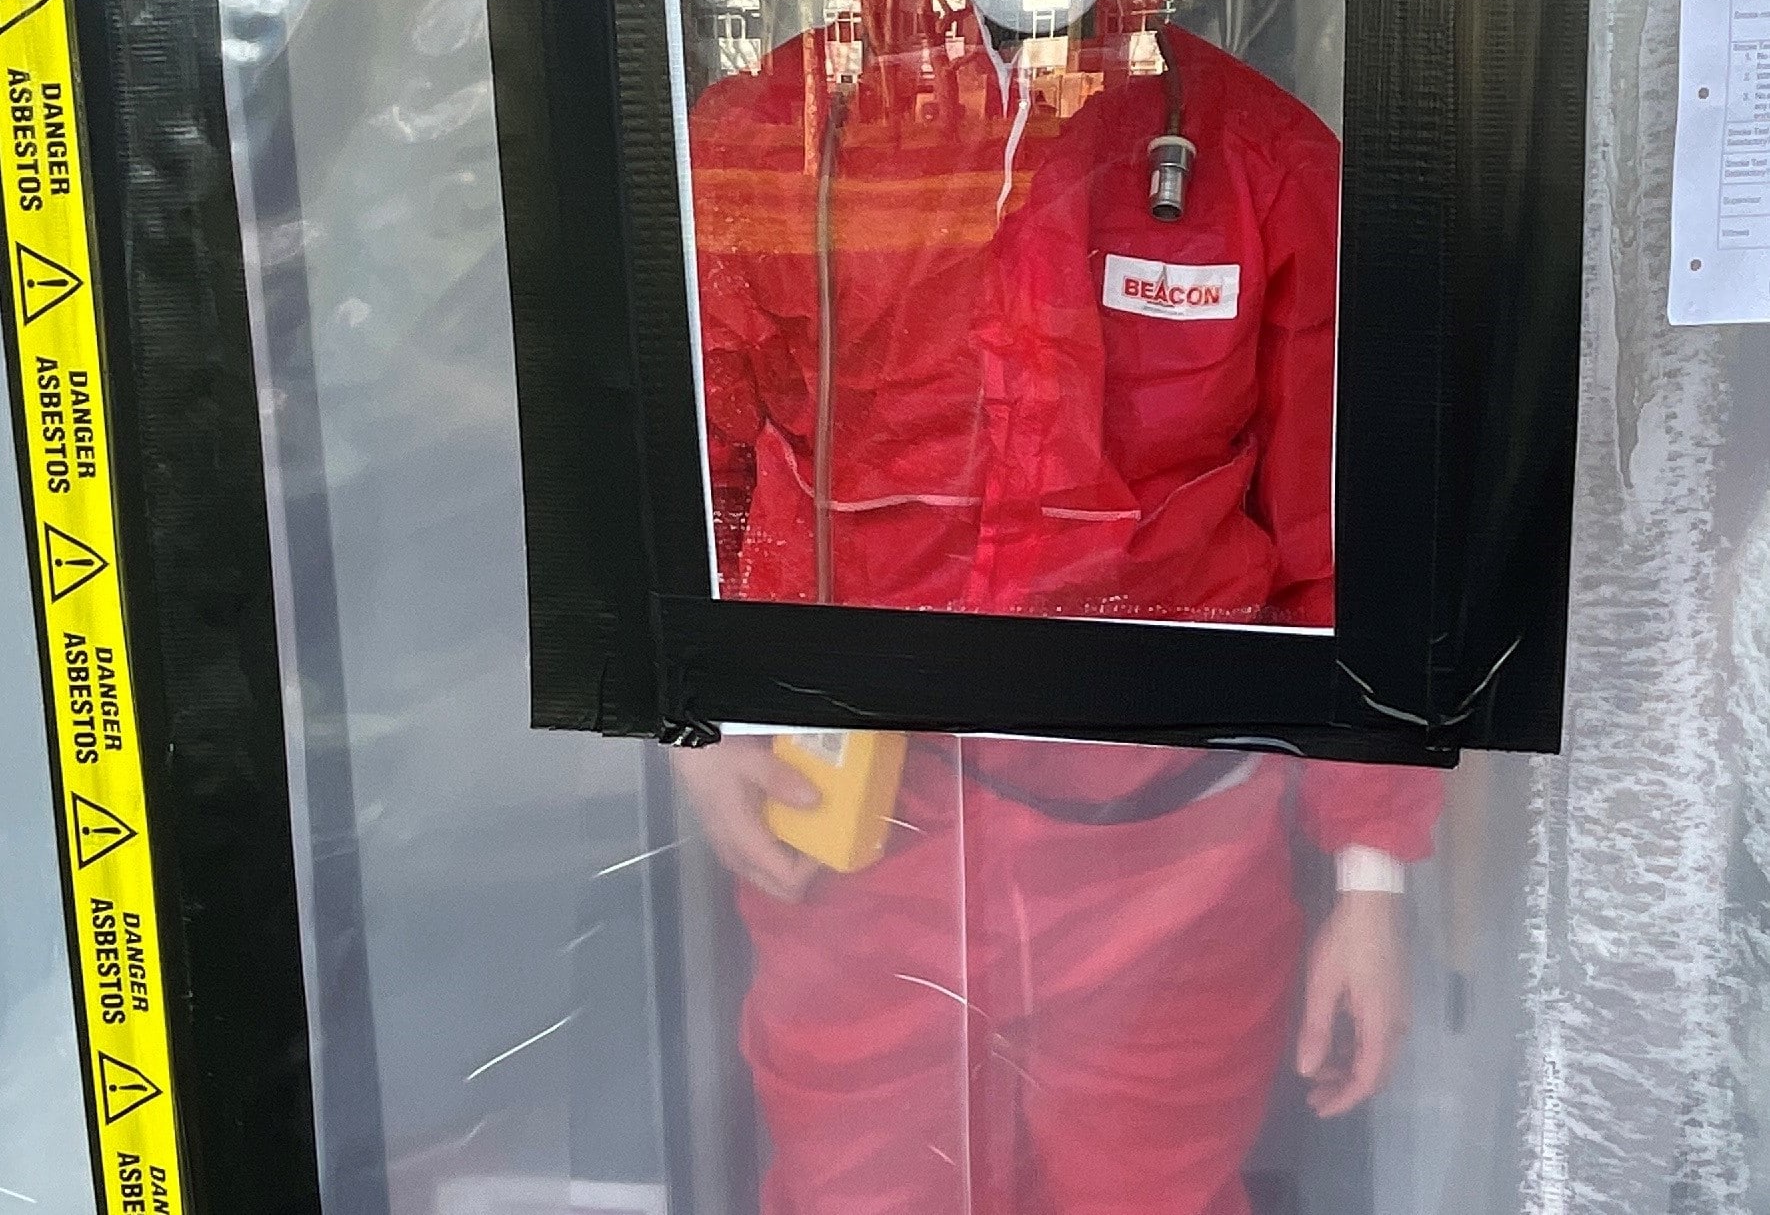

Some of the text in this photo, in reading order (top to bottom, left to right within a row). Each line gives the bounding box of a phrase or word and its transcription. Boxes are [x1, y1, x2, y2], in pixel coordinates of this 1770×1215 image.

[7, 67, 43, 212] ASBESTOS
[41, 83, 71, 196] DANGER
[1124, 277, 1221, 305] BEACON
[35, 355, 71, 494] ASBESTOS
[69, 371, 96, 479] DANGER
[63, 631, 98, 764] ASBESTOS
[95, 646, 122, 751] DANGER
[90, 897, 126, 1025] ASBESTOS
[122, 912, 149, 1012] DANGER
[116, 1150, 146, 1215] ASBE
